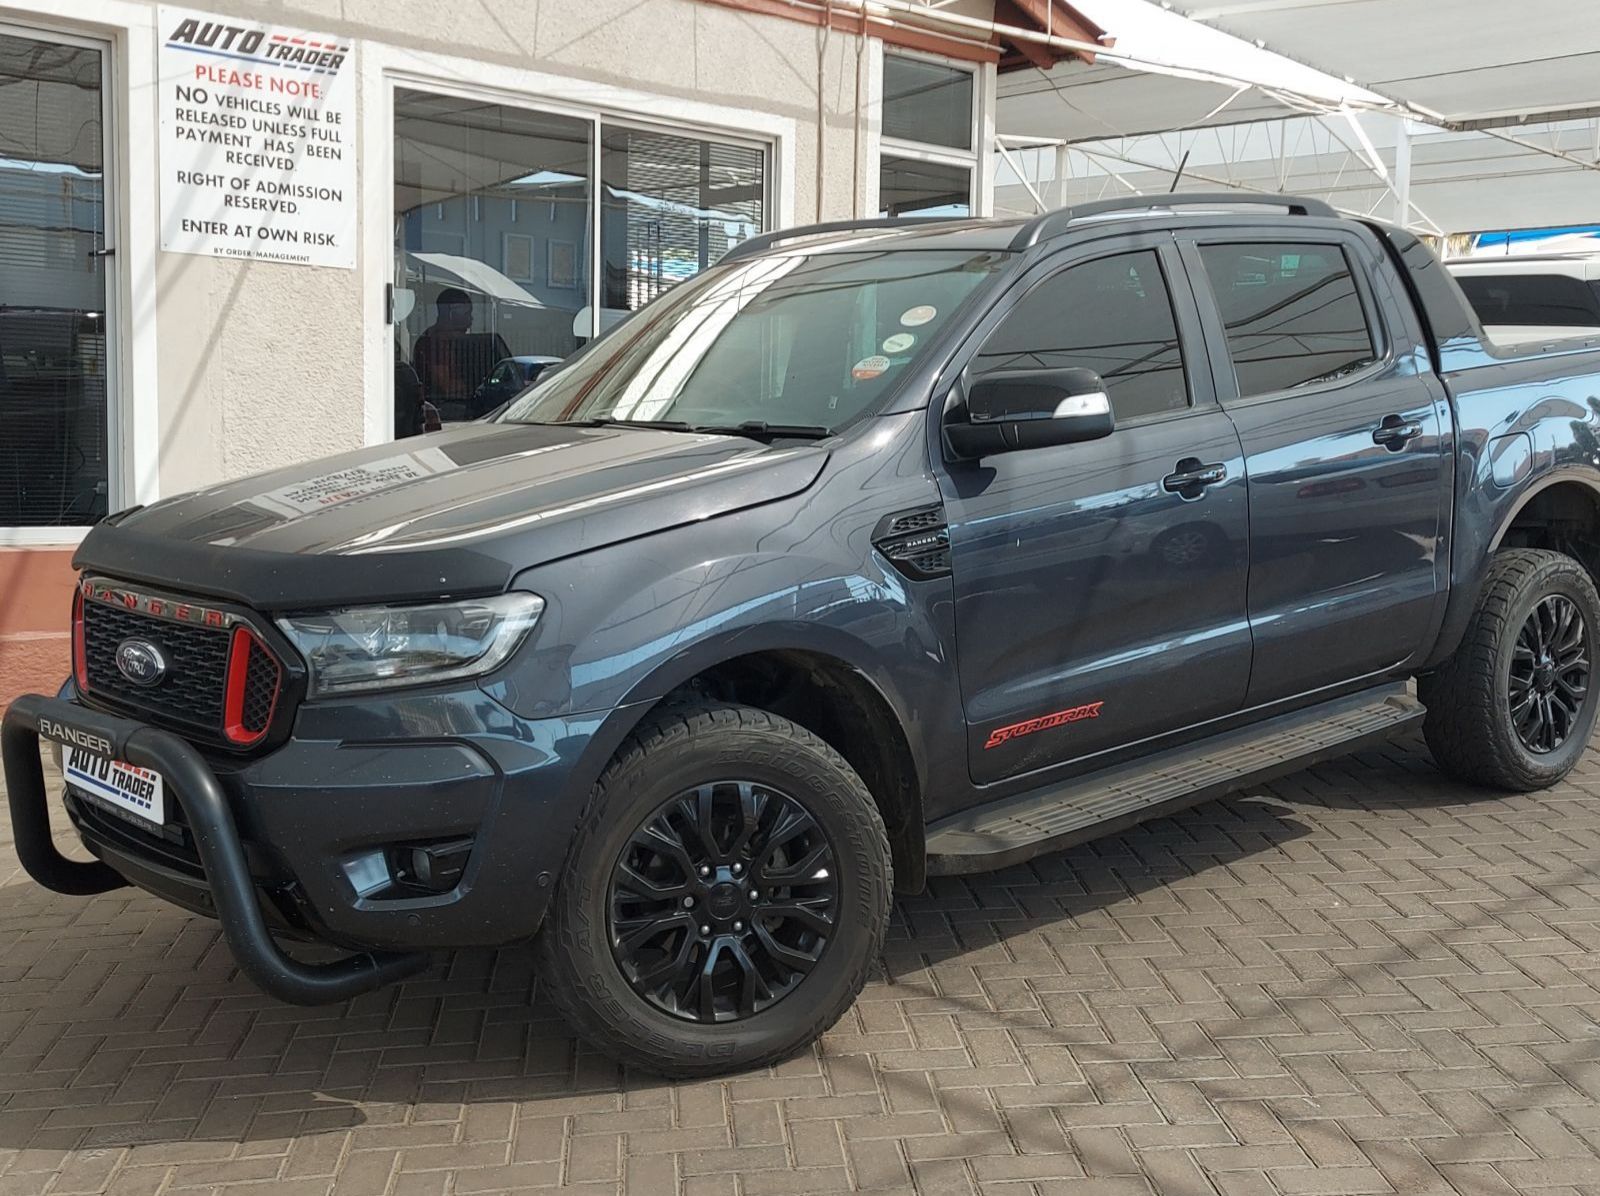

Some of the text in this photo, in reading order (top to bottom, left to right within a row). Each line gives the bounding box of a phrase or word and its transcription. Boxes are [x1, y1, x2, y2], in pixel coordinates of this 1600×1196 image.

[169, 19, 265, 54] AUTO
[267, 43, 345, 69] TRADER
[195, 65, 263, 90] PLEASE
[175, 84, 342, 125] NO VEHICLES WILL BE
[175, 107, 342, 143] RELEASED UNLESS FULL
[175, 126, 342, 161] PAYMENT HAS BEEN
[176, 170, 343, 202] RIGHT OF ADMISSION
[181, 218, 228, 237] ENTER
[234, 225, 253, 239] AT
[257, 226, 298, 243] OWN
[213, 247, 224, 255] BY
[255, 250, 310, 262] MANAGEMENT
[907, 536, 937, 547] RANGER
[84, 583, 222, 626] RANGER
[121, 647, 147, 676] Ford
[40, 719, 112, 755] RANGER
[984, 701, 1105, 750] STORMTRAK
[69, 748, 154, 802] AUTO TRADER
